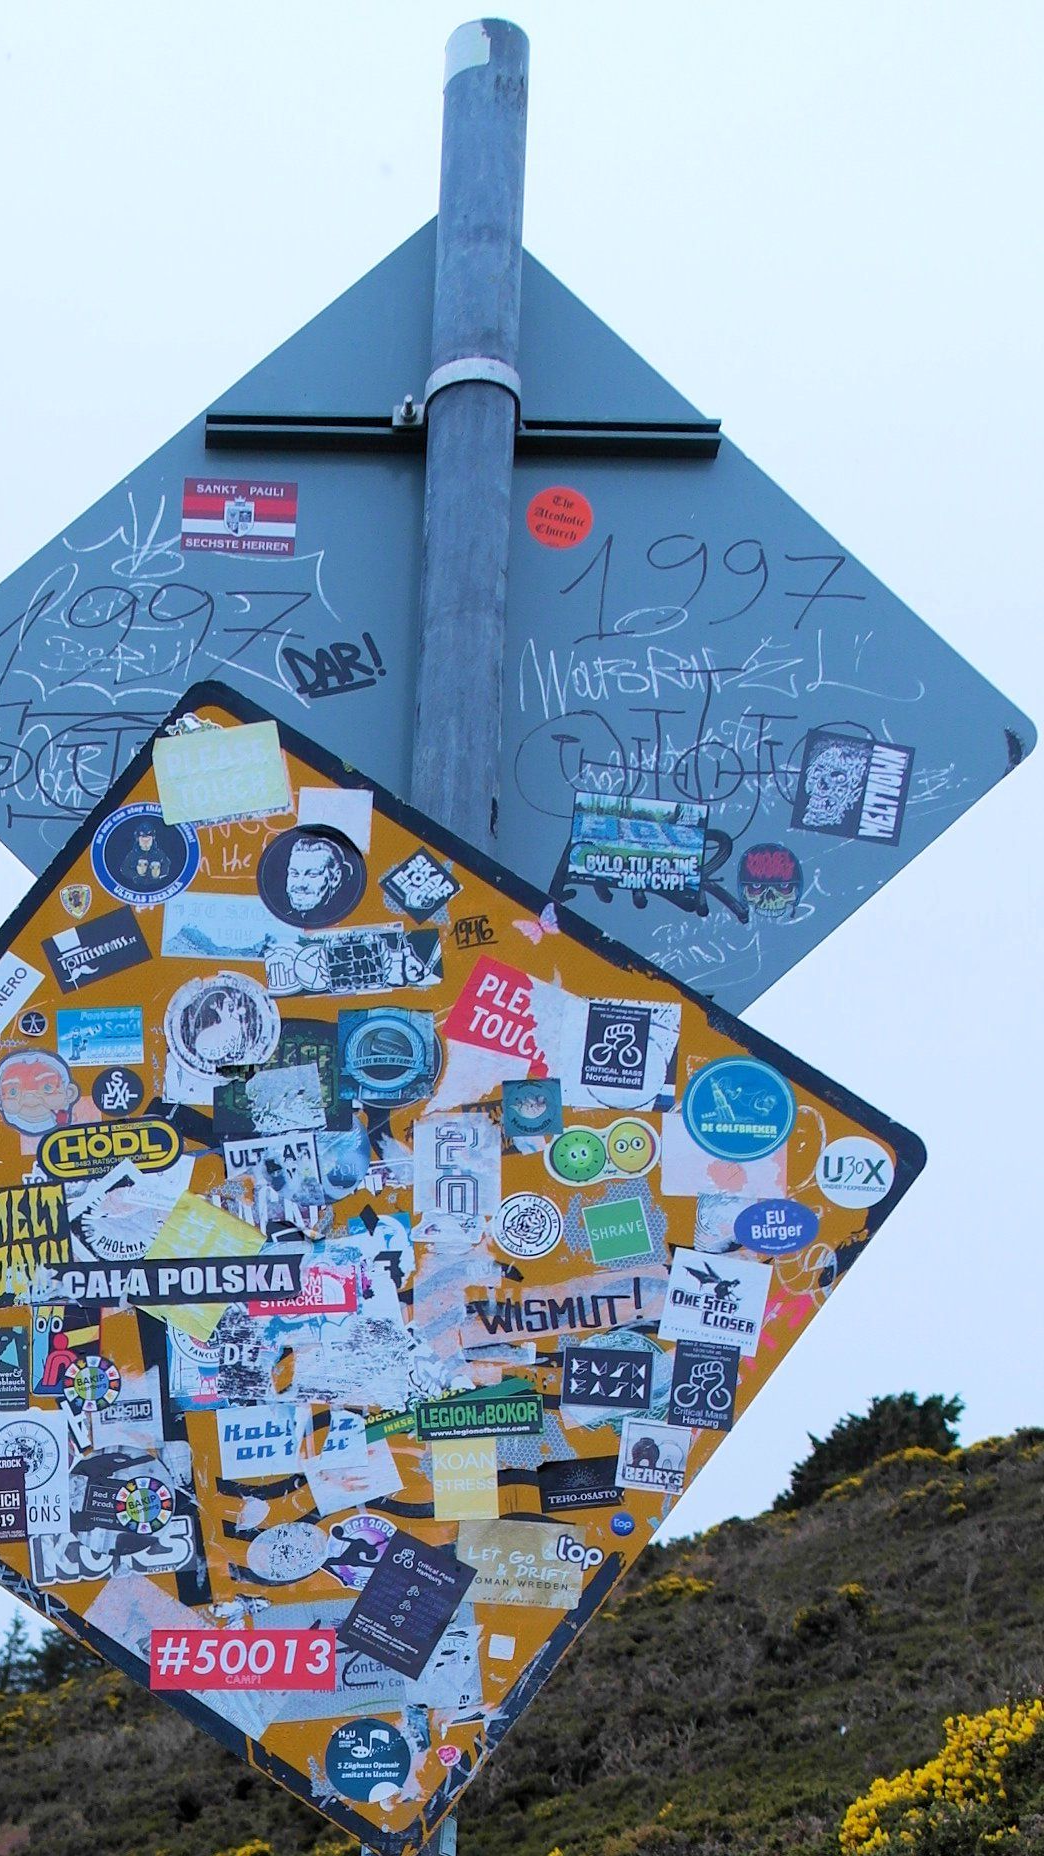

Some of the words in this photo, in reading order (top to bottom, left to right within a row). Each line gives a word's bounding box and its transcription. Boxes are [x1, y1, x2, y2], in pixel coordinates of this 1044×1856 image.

[196, 484, 237, 494] SANKT
[249, 486, 284, 497] PAULI
[553, 495, 574, 509] The
[534, 507, 585, 527] Alcoholic
[535, 523, 577, 541] Church
[185, 538, 238, 549] SECHSTE
[242, 540, 289, 551] HERREN
[559, 533, 867, 644] 1997
[282, 631, 387, 692] DAR!
[858, 744, 910, 838] MELTDOWN
[127, 804, 144, 814] stop
[586, 855, 624, 870] BYLO
[629, 857, 652, 872] TU
[113, 884, 147, 903] ULTRAS
[104, 1020, 141, 1035] Saúl
[585, 1065, 619, 1075] CRITICAL
[622, 1069, 643, 1077] MASS
[585, 1072, 642, 1086] Norderstedt
[701, 1122, 714, 1133] DE
[716, 1123, 778, 1135] GOLFBREKER
[57, 1125, 163, 1162] HÖDL
[847, 1184, 887, 1193] EXPERIENCES
[766, 1209, 786, 1225] EU
[591, 1219, 645, 1241] SHRAVE
[750, 1222, 803, 1241] Bürger
[61, 1269, 151, 1300] CAŁA
[158, 1263, 295, 1297] POLSKA
[473, 1276, 644, 1336] WISMUT!
[703, 1295, 738, 1314] STEP
[703, 1310, 755, 1334] CLOSER
[188, 1345, 220, 1358] FANCLU
[76, 1374, 106, 1386] BAKIP
[420, 1407, 478, 1429] LEGION
[486, 1401, 539, 1424] BOKOR
[673, 1405, 703, 1418] Critical
[705, 1408, 729, 1421] Mass
[681, 1415, 719, 1429] Harburg
[430, 1425, 531, 1437] www.legionofbokor.com
[433, 1452, 496, 1471] KOAN
[433, 1478, 496, 1493] STRESS
[92, 1491, 108, 1499] Red
[547, 1489, 618, 1505] TEHO-OSASTO
[467, 1545, 497, 1562] LET
[509, 1550, 536, 1565] GO
[415, 1567, 443, 1587] Hamburg
[417, 1560, 440, 1576] Critical
[438, 1571, 456, 1585] Mass
[515, 1564, 570, 1583] DRIFT
[474, 1576, 510, 1587] OMAN
[517, 1578, 570, 1592] WREDEN
[157, 1636, 332, 1676] #50013
[373, 1761, 400, 1771] Openair
